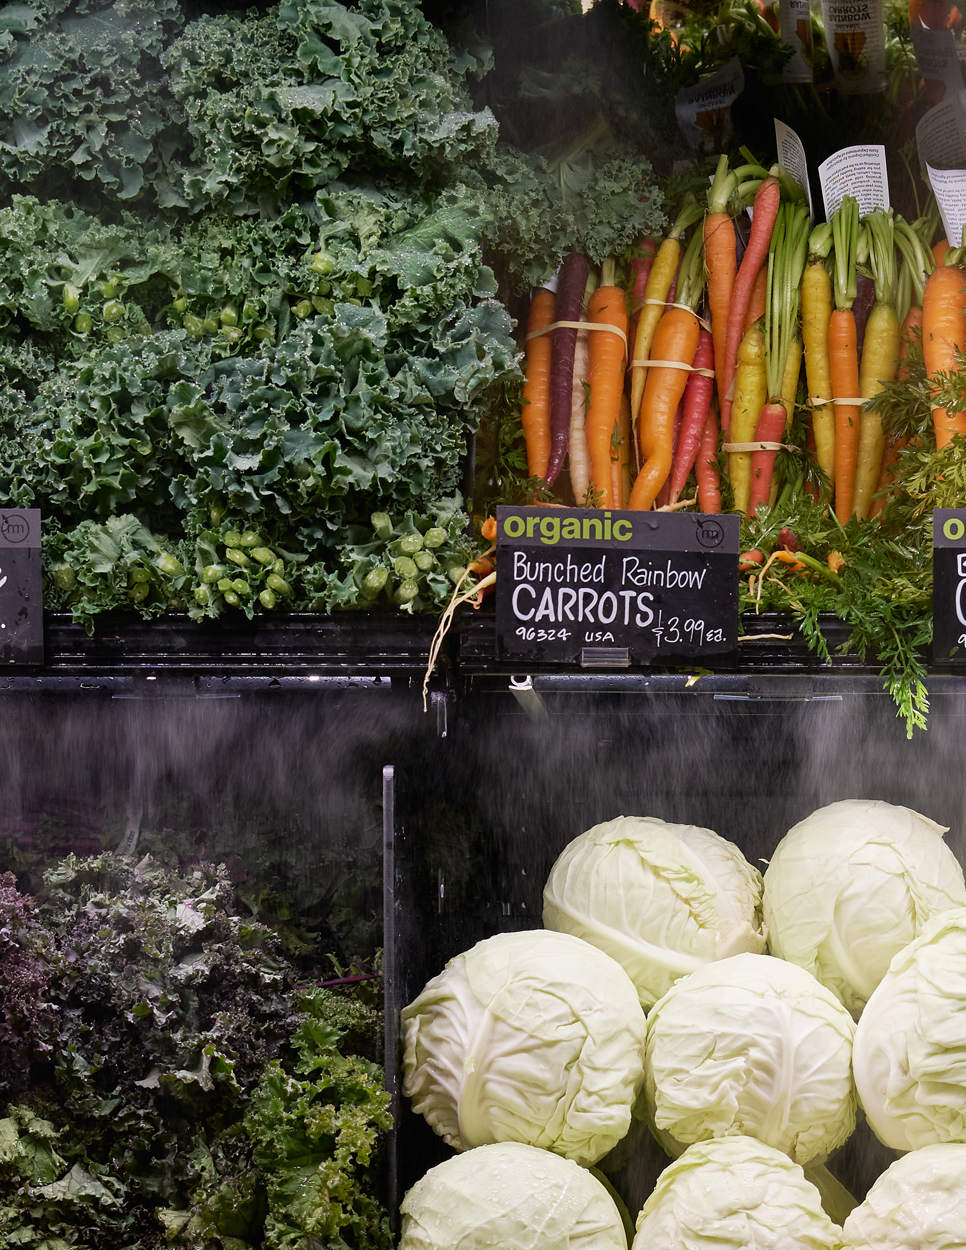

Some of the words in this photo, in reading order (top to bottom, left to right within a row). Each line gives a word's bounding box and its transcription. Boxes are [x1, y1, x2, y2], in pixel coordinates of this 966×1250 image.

[503, 511, 633, 545] organic
[513, 551, 606, 584] Bunched
[622, 556, 707, 589] Rainbow
[512, 584, 654, 627] CARROTS
[516, 627, 571, 642] 96324
[585, 632, 615, 642] USA
